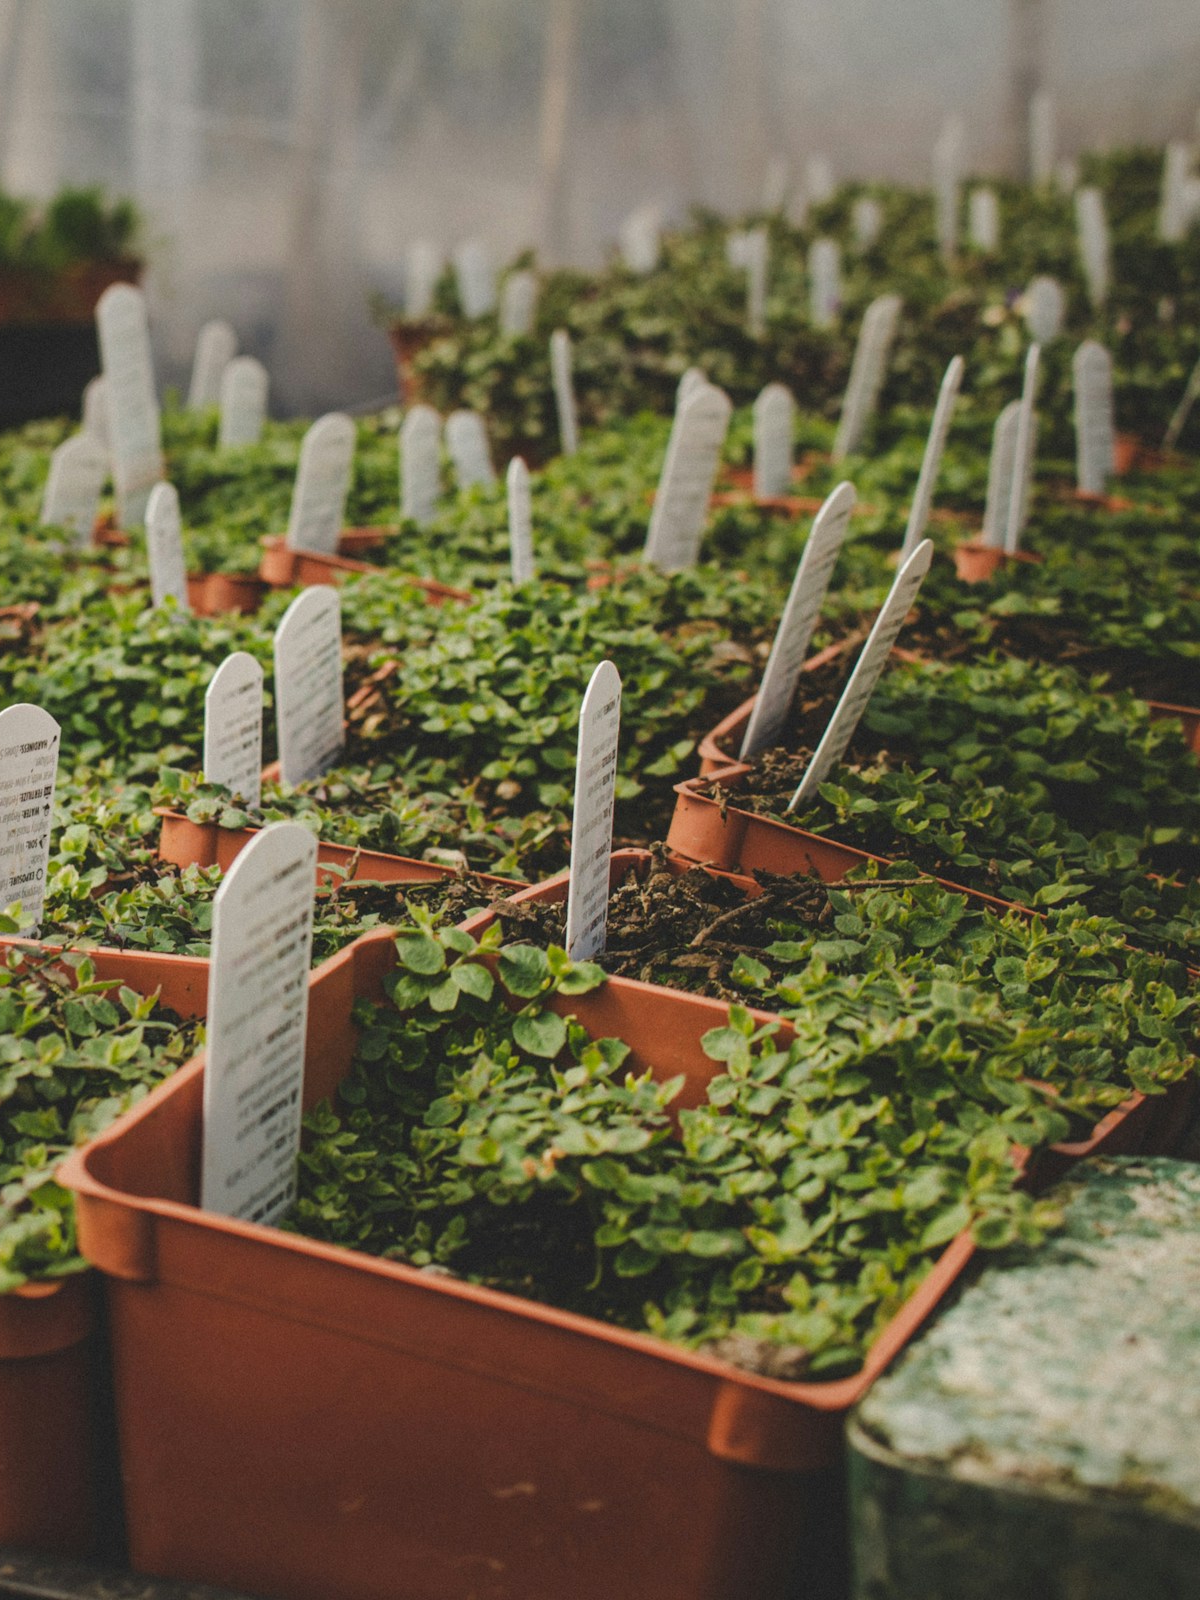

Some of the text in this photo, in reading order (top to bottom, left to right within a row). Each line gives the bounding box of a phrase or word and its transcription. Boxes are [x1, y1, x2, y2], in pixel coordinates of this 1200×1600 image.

[4, 745, 18, 758] Zones
[19, 739, 47, 753] HARDINESS:
[0, 794, 18, 808] Fertilize
[19, 788, 42, 802] FERTILIZE:
[2, 808, 20, 824] Regular
[21, 806, 39, 819] WATER:
[25, 838, 37, 850] SOIL:
[8, 871, 34, 886] EXPOSURE:
